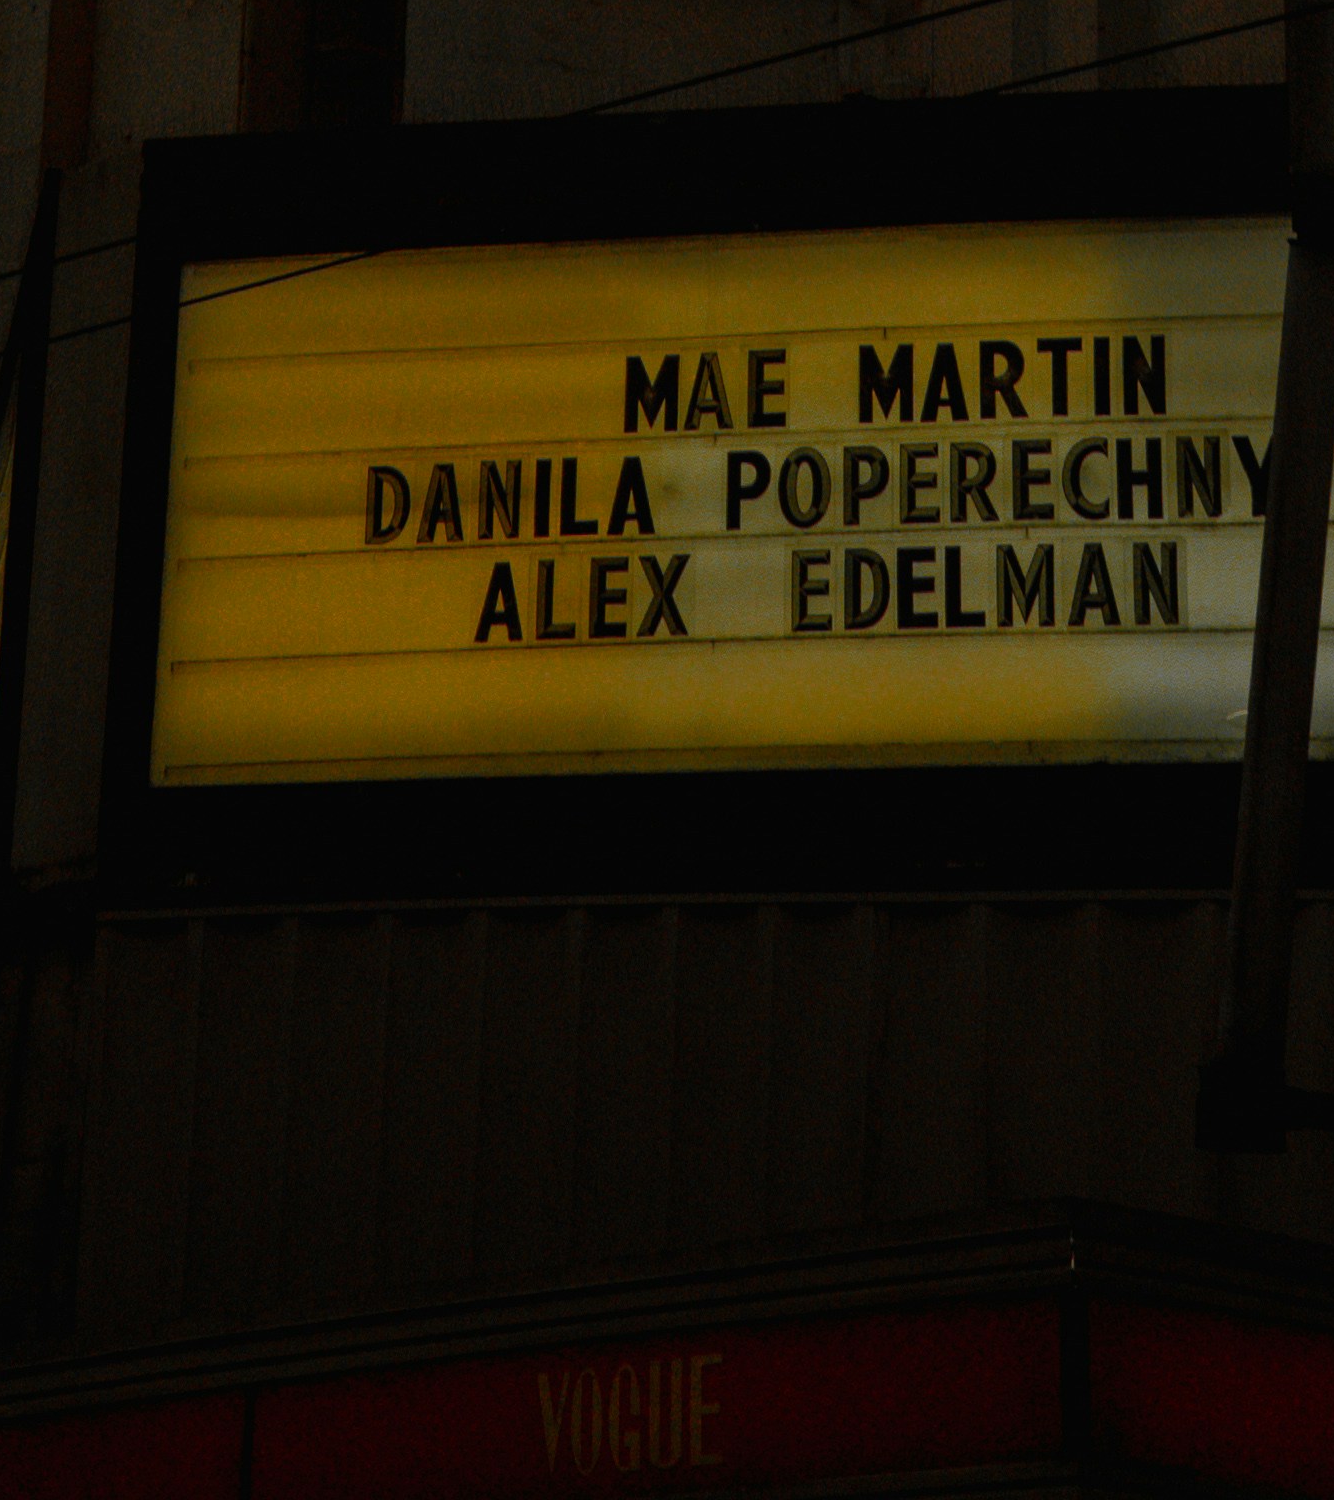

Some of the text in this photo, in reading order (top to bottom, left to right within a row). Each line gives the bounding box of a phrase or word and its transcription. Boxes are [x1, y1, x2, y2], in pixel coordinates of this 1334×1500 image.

[624, 348, 787, 434] MAE
[858, 334, 1167, 424] MARTIN
[364, 455, 656, 545] DANILA
[726, 433, 1274, 531] POPERECHNY
[474, 553, 691, 643] ALEX
[791, 541, 1180, 632] EDELMAN
[537, 1352, 725, 1477] VOGUE
